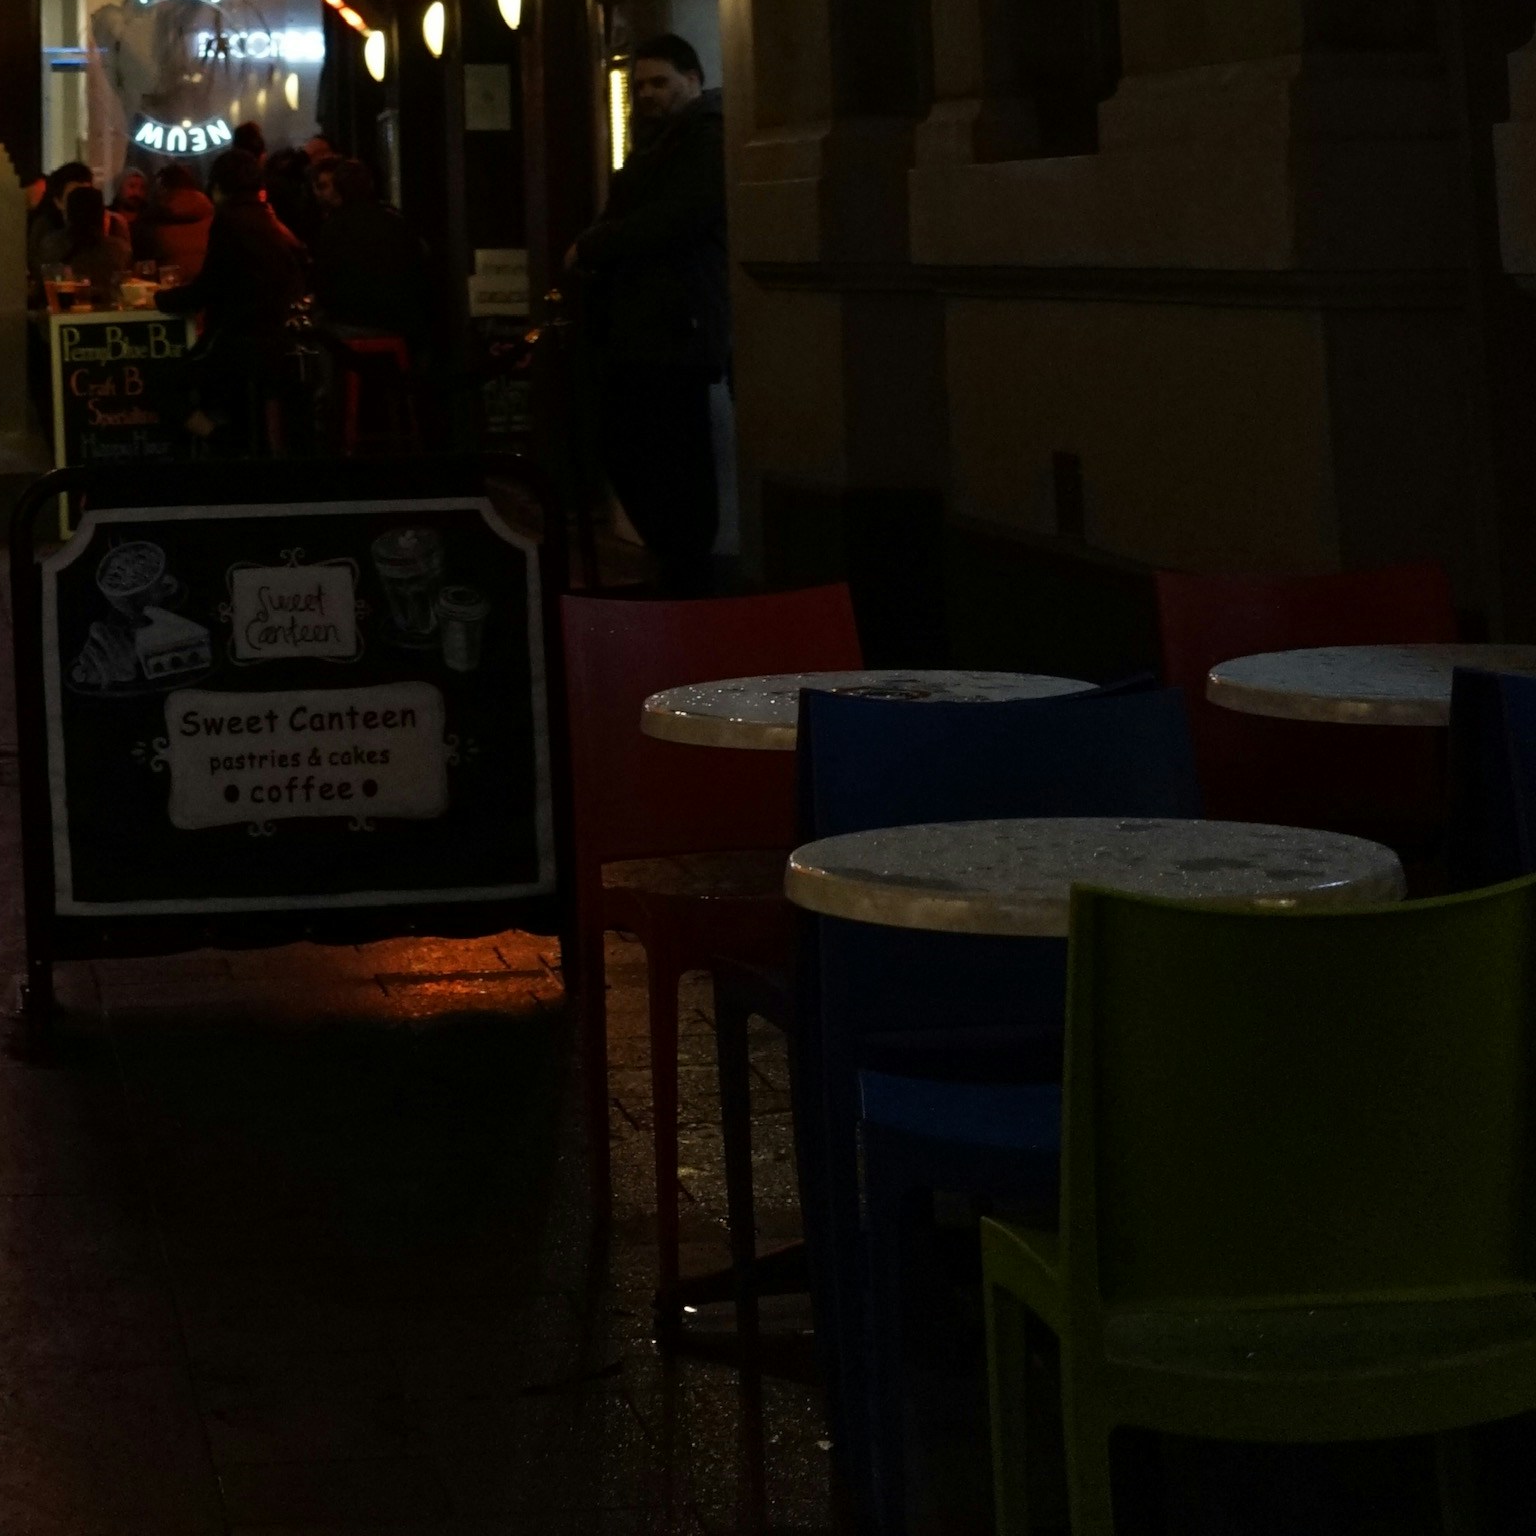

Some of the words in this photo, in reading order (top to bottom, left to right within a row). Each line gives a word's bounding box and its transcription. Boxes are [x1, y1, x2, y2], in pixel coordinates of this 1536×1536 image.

[256, 584, 327, 625] Sweet
[244, 614, 344, 650] Canteen
[179, 708, 280, 738] Sweet
[289, 705, 417, 733] Canteen
[209, 748, 302, 773] pastries
[328, 745, 391, 768] cakes
[250, 775, 355, 804] coffee
